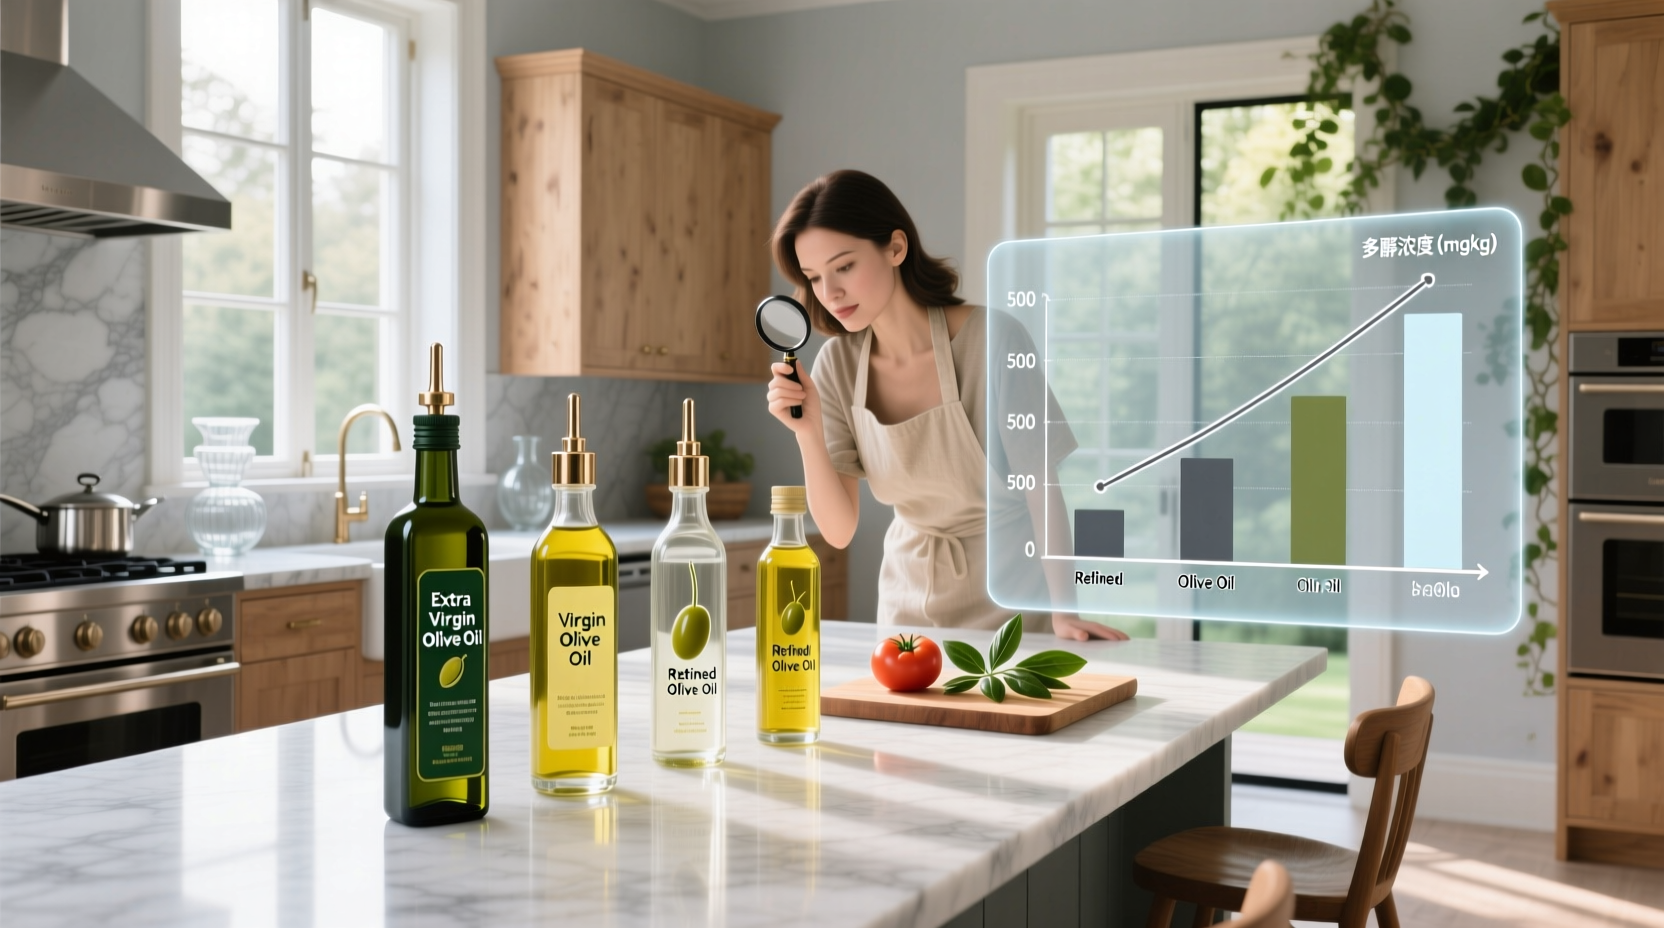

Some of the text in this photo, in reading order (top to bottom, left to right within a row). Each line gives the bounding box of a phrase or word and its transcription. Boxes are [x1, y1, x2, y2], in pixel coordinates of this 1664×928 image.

[1007, 291, 1036, 307] 500
[1007, 352, 1036, 369] 500
[1007, 413, 1036, 430] 500
[1007, 474, 1036, 490] 500
[1024, 541, 1035, 557] 0
[1178, 574, 1236, 590] Olive Oil
[431, 591, 471, 608] Extra
[428, 611, 476, 631] Virgin
[558, 612, 606, 632] Virgin
[422, 629, 482, 648] Olive Oil
[560, 631, 601, 647] Olive
[569, 650, 591, 666] Oil
[772, 659, 816, 672] Olive Oil
[667, 682, 717, 696] Olive Oil
